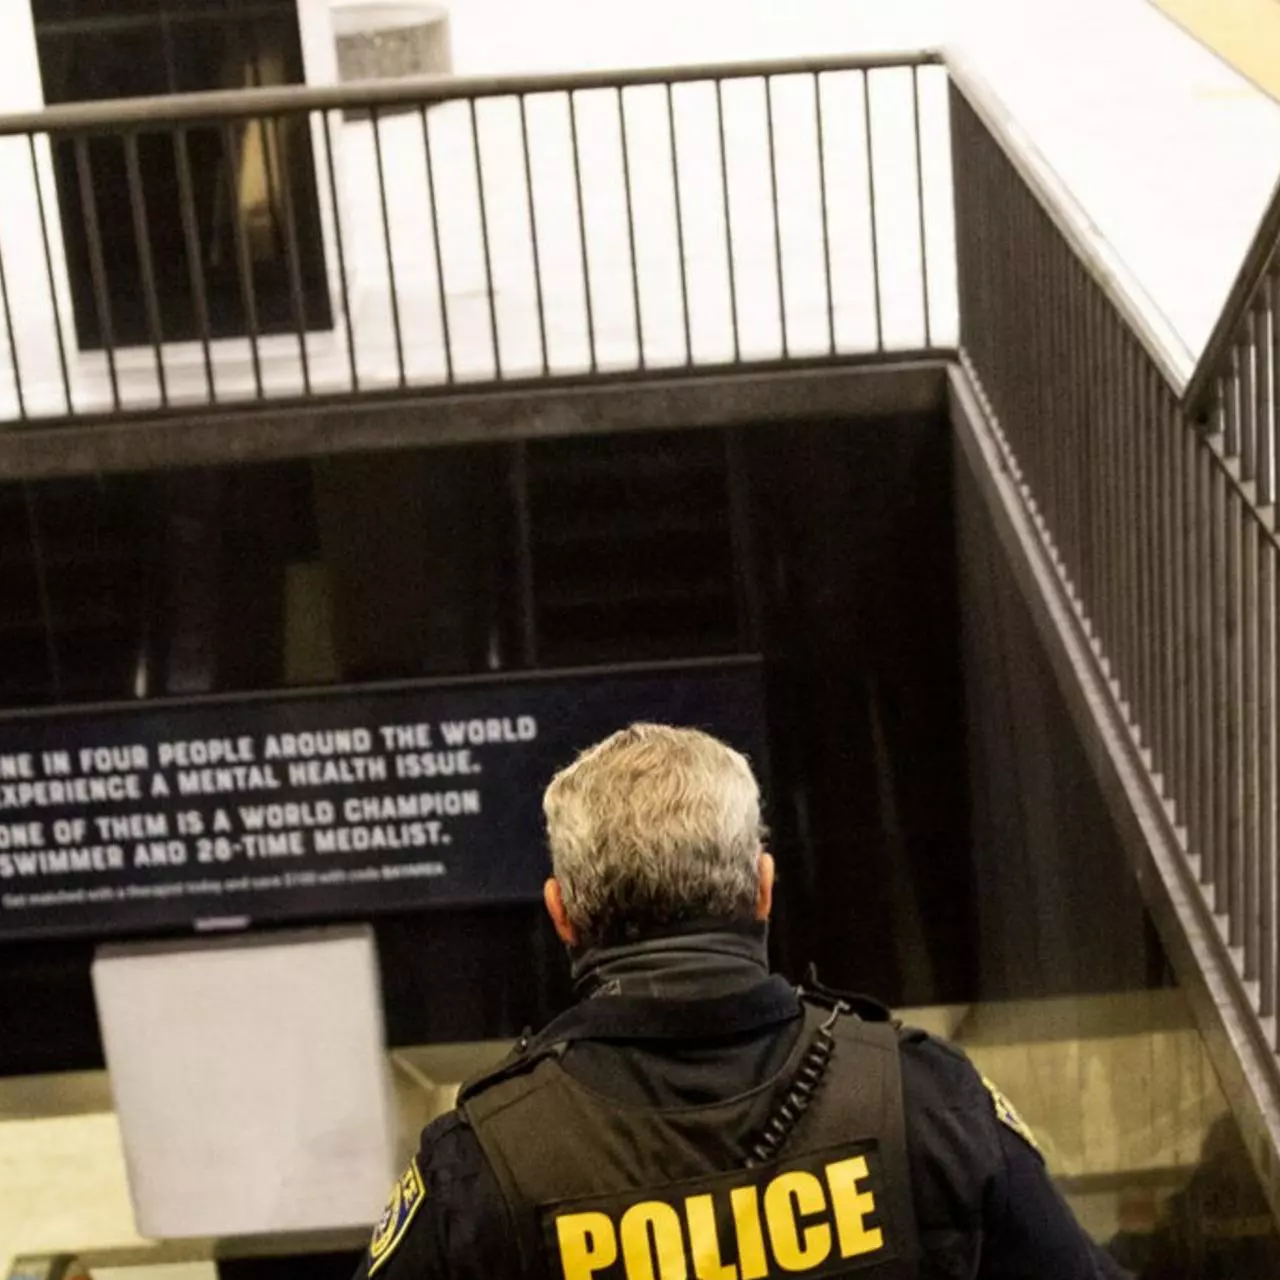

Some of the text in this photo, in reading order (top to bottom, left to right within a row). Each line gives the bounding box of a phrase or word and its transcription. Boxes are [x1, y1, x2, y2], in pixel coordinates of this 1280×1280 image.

[42, 751, 70, 776] IN
[79, 745, 149, 772] FOUR
[158, 736, 255, 768] PEOPLE
[265, 728, 371, 759] AROUND
[379, 723, 433, 749] THE
[440, 715, 538, 745] WORLD
[151, 773, 170, 797] A
[177, 764, 280, 795] MENTAL
[288, 755, 387, 786] HEALTH
[396, 750, 481, 778] ISSUE.
[53, 818, 86, 844] OF
[94, 813, 169, 840] THEM
[176, 810, 204, 835] IS
[213, 808, 231, 833] A
[238, 800, 336, 830] WORLD
[343, 789, 481, 822] CHAMPION
[133, 840, 188, 869] AND
[196, 830, 304, 863] 28-TIME
[314, 821, 451, 854] MEDALIST.
